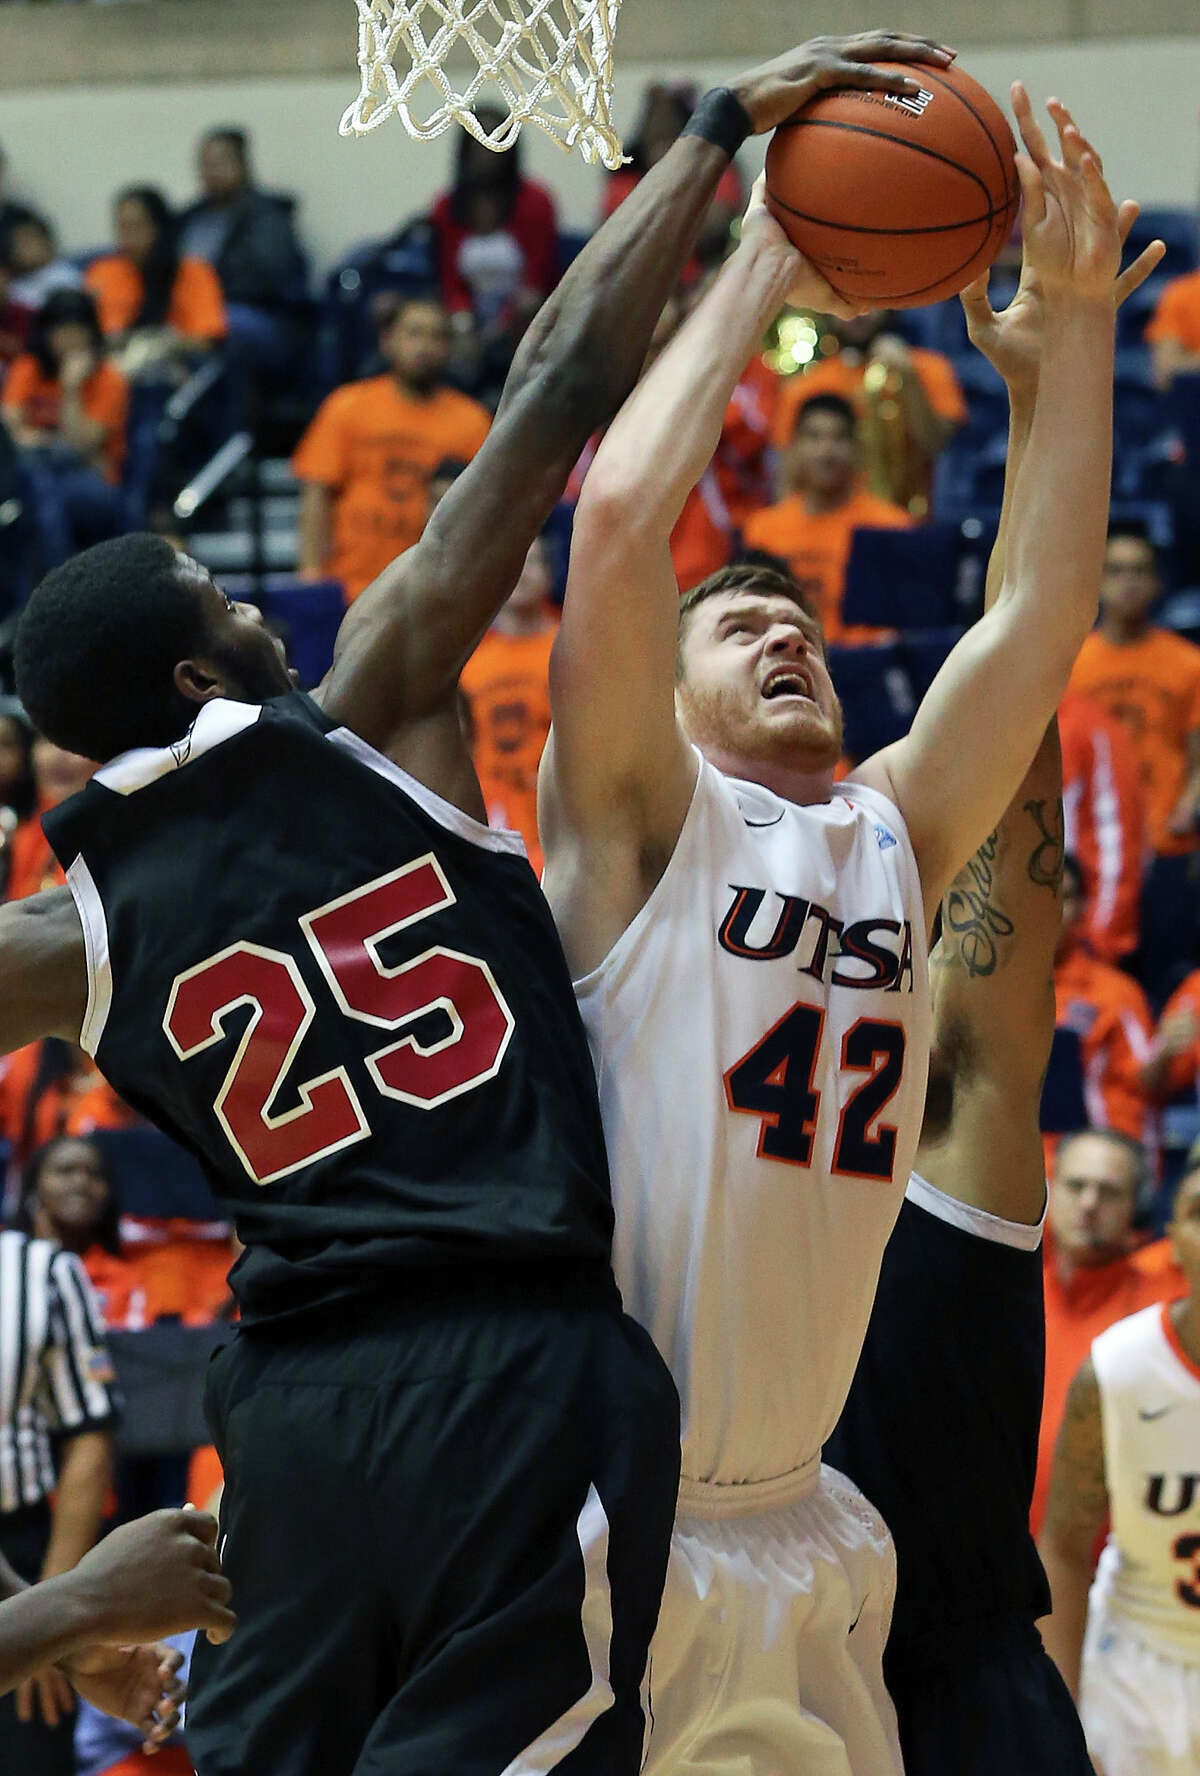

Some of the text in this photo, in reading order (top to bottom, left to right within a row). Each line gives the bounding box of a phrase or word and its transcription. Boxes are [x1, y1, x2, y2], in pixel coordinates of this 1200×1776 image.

[162, 851, 515, 1186] 25
[718, 883, 914, 993] UTSA
[723, 1000, 906, 1183] 42
